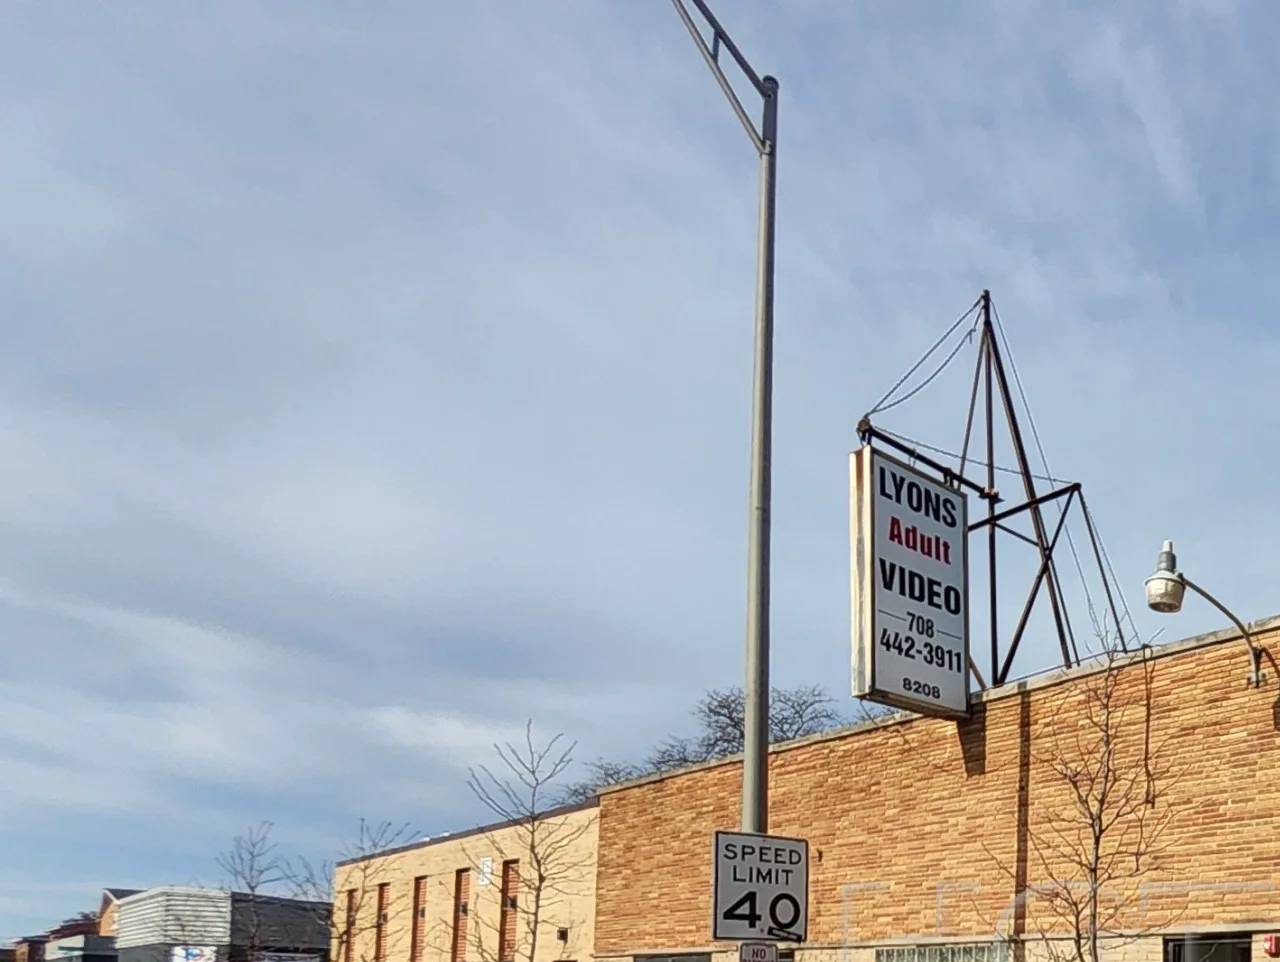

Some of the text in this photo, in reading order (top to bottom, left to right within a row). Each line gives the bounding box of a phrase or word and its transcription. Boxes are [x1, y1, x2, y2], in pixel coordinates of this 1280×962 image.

[879, 466, 957, 528] LYONS
[889, 516, 951, 565] Adult
[879, 557, 961, 615] VIDEO
[906, 611, 934, 638] 708
[880, 627, 962, 673] 442-3911
[902, 677, 941, 700] 8208
[723, 843, 802, 865] SPEED
[733, 865, 793, 886] LIMIT
[723, 891, 800, 929] 40
[751, 948, 766, 960] NO
